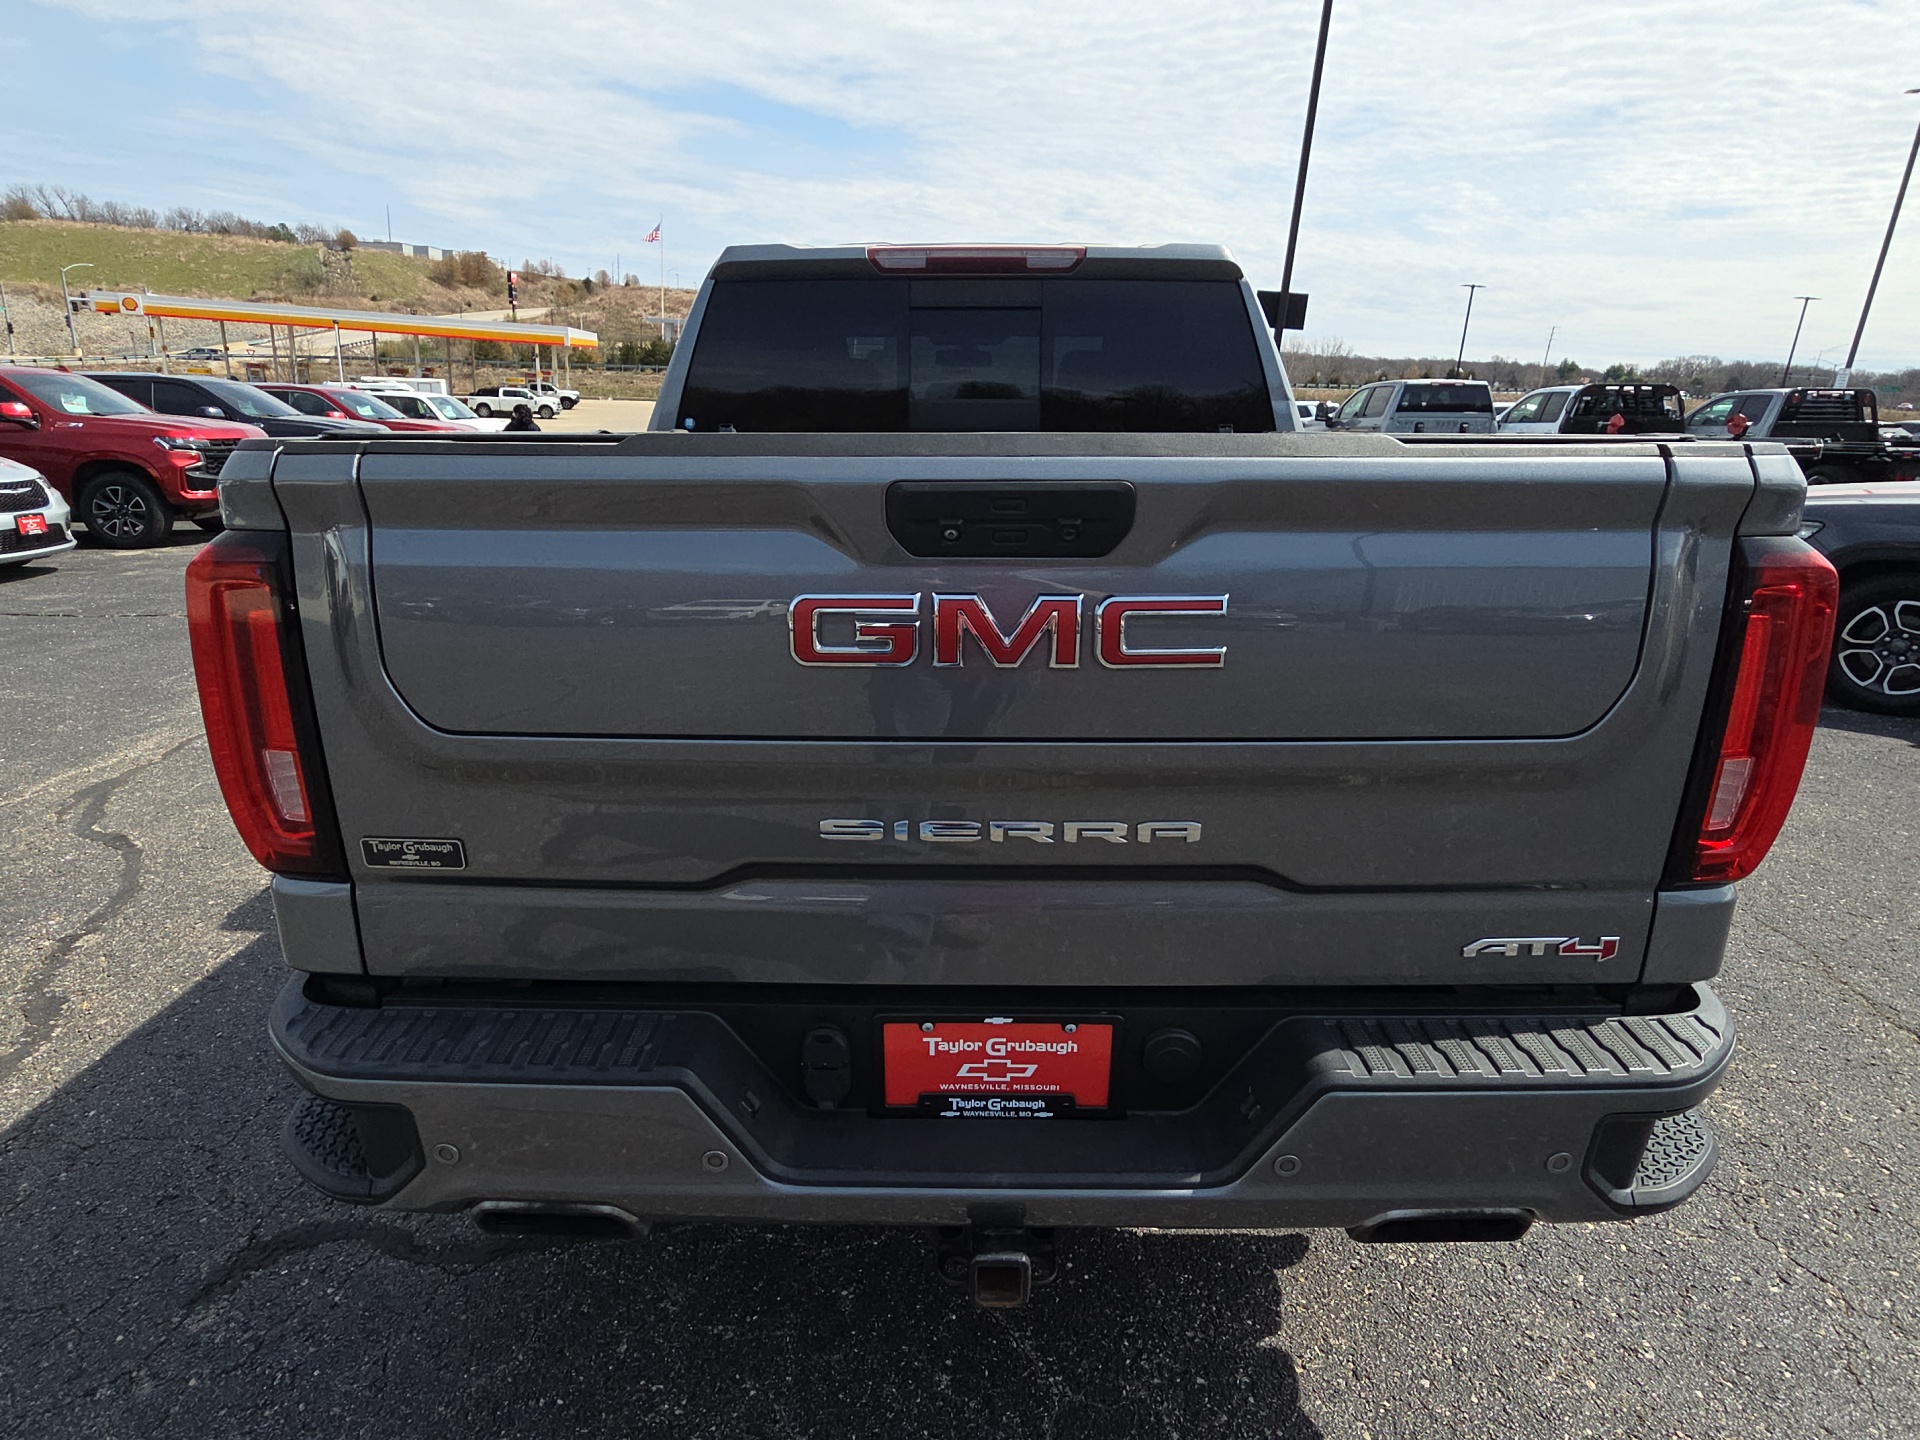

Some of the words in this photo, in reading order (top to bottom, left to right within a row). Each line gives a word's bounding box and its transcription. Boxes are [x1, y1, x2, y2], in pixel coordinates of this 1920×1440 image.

[788, 592, 1230, 669] GMC
[819, 819, 1202, 844] SIERRA
[368, 840, 402, 853] Taylor
[403, 841, 453, 854] Grubaugh
[1462, 937, 1621, 962] AT4
[922, 1037, 983, 1056] Taylor
[985, 1037, 1078, 1056] Grubaugh
[939, 1083, 1010, 1091] WAYNESVILLE,
[948, 1098, 986, 1110] Taylor
[987, 1098, 1045, 1110] Grubaugh
